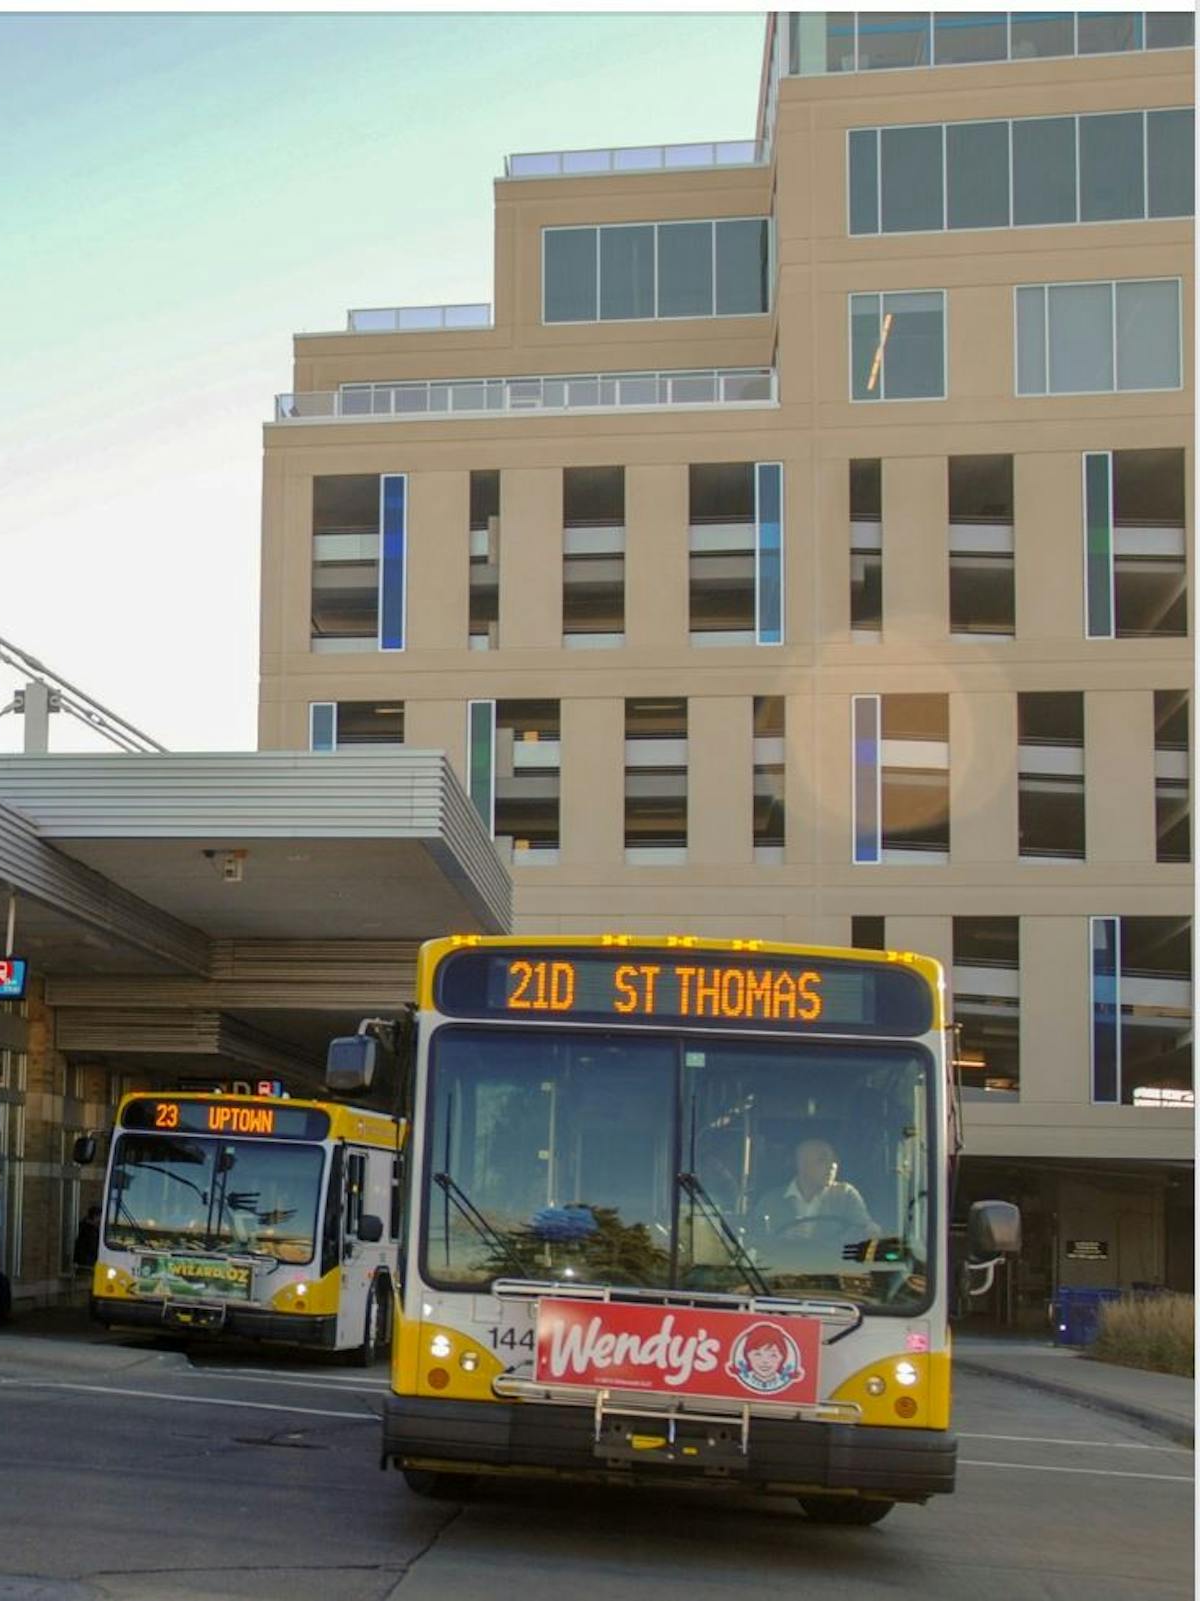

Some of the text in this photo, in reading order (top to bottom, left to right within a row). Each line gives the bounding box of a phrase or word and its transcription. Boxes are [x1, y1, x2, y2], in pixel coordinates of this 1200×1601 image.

[506, 960, 824, 1020] 21D ST THOMAS
[155, 1103, 274, 1133] 23 UPTOWN
[551, 1313, 720, 1386] Wendy's
